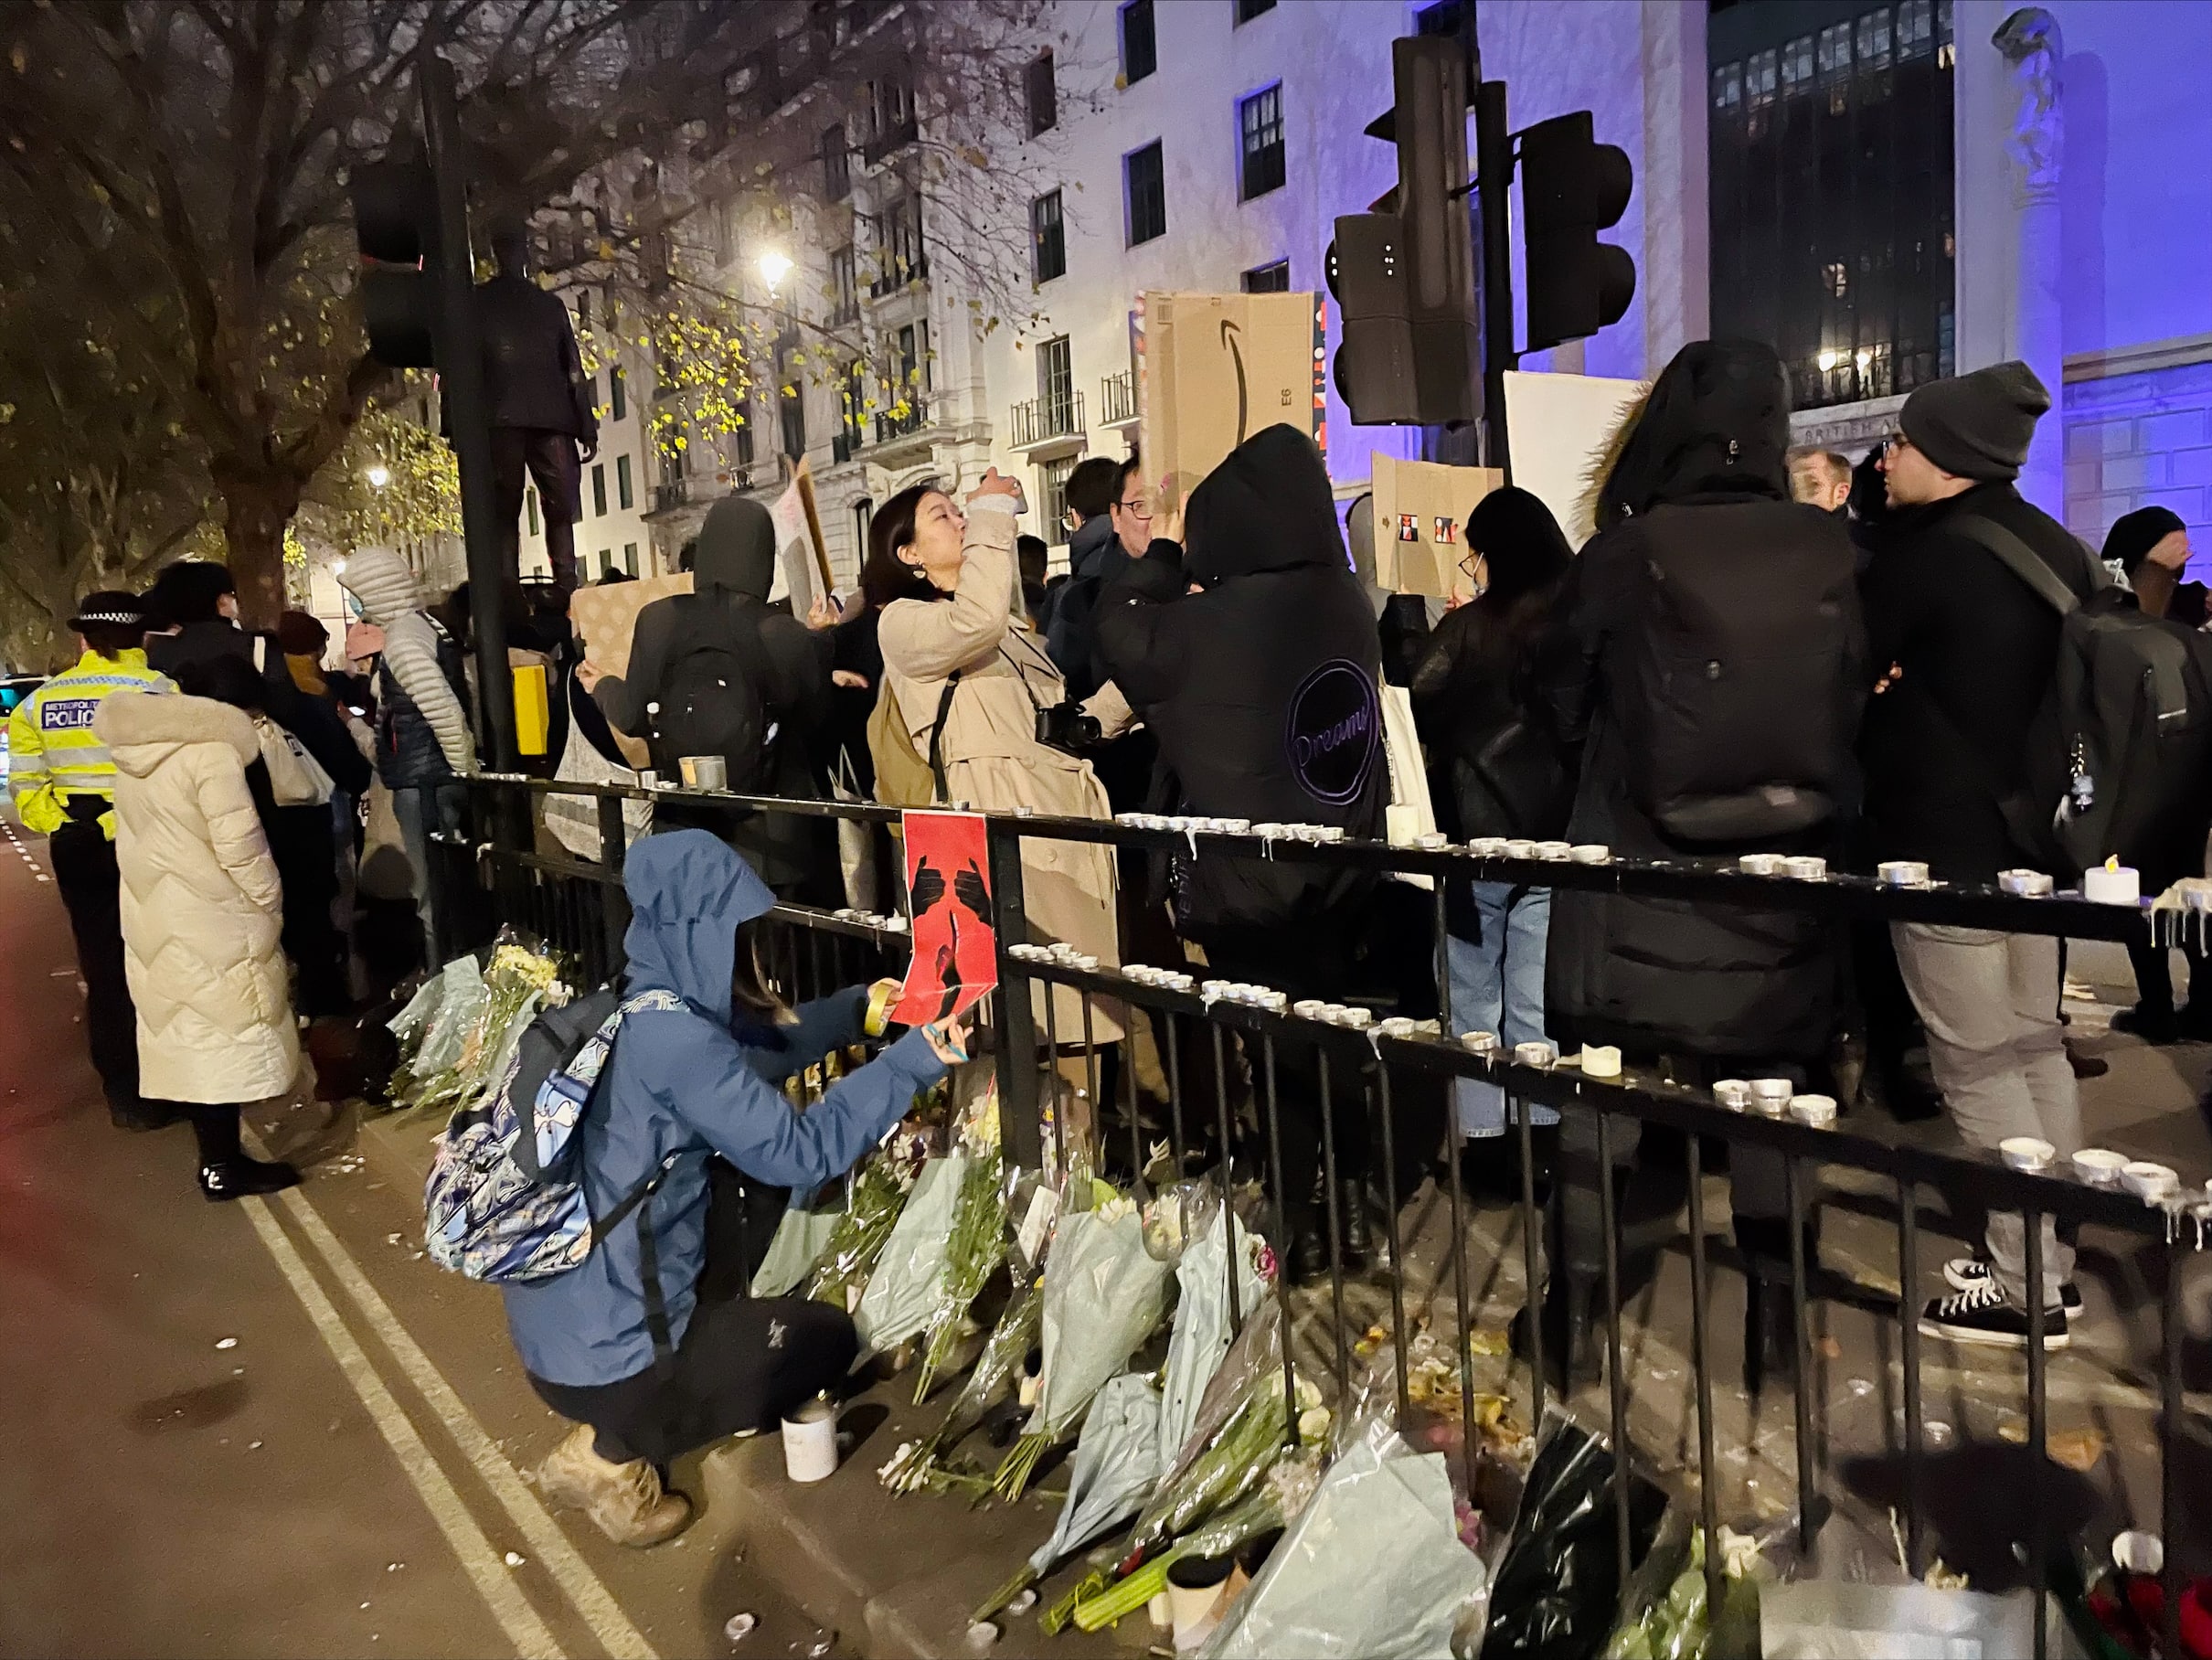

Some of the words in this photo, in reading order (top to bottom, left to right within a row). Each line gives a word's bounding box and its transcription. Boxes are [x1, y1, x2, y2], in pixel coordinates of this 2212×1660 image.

[1281, 388, 1292, 407] E6
[1805, 421, 1872, 443] BRITISH
[46, 701, 98, 711] METROPOLIT
[46, 709, 94, 727] POLIC
